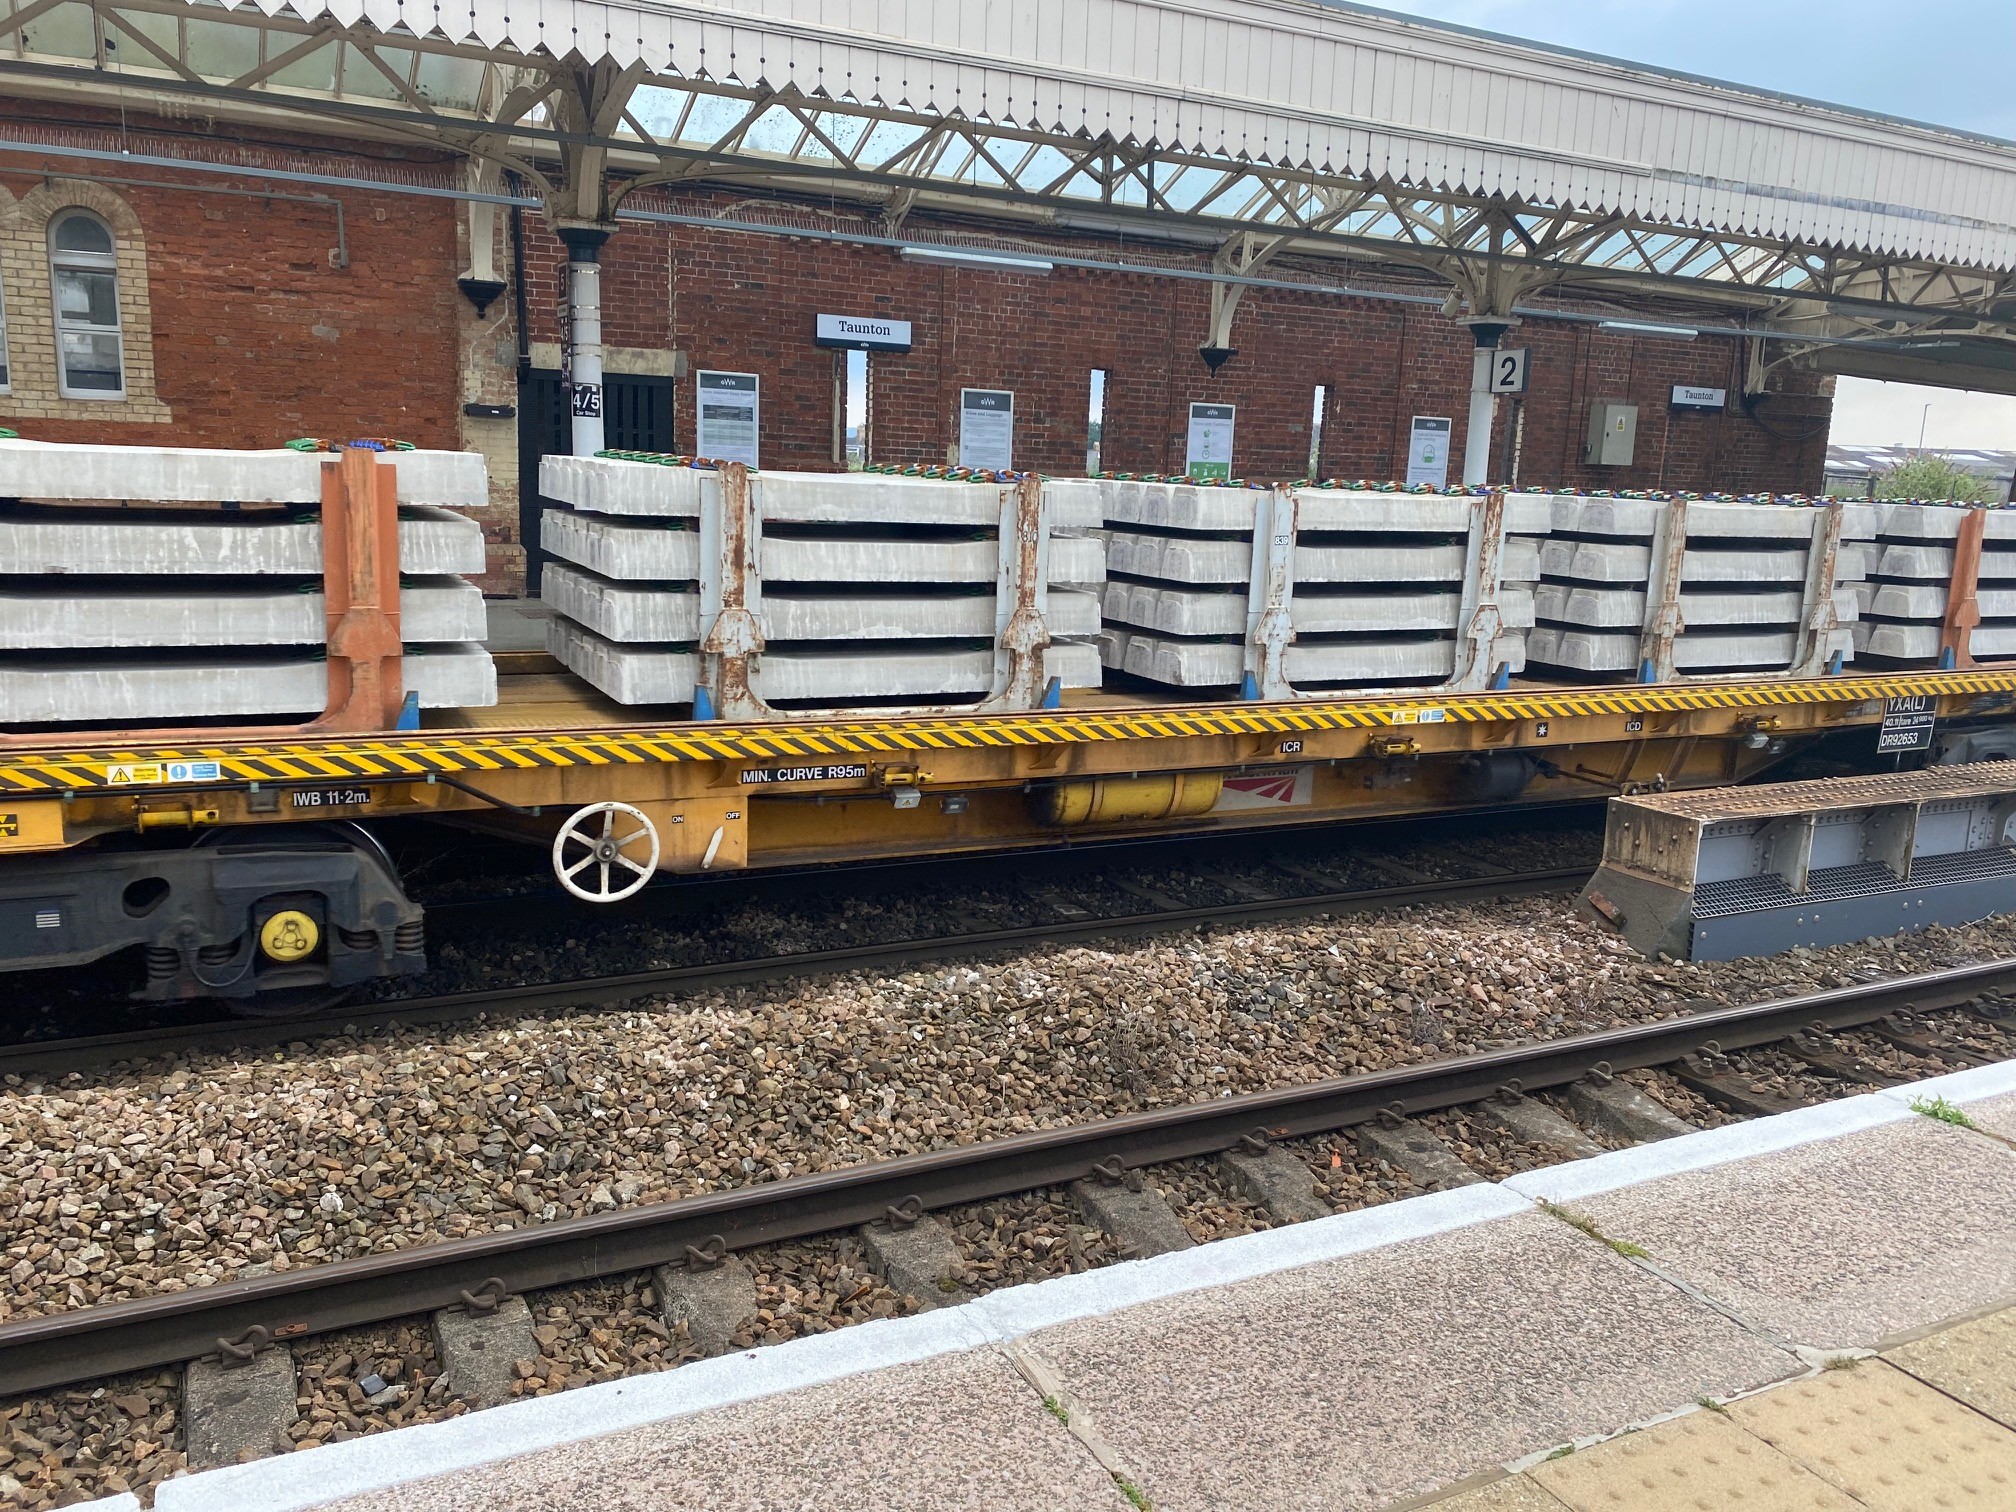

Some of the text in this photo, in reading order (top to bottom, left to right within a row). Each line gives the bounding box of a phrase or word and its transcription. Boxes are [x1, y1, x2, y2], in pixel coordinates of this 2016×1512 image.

[838, 320, 891, 336] Taunton
[1500, 356, 1516, 386] 2
[720, 378, 736, 386] GWR
[573, 392, 600, 409] 4/5
[981, 397, 995, 406] GWR
[1684, 389, 1714, 401] Taunton
[1275, 536, 1288, 545] 839
[1889, 696, 1926, 711] YXA(L)
[1627, 721, 1641, 731] ICD
[1282, 741, 1300, 752] ICR
[1881, 732, 1918, 747] DR92653
[742, 765, 866, 783] MIN. CURVE R95m
[293, 791, 321, 806] IWB
